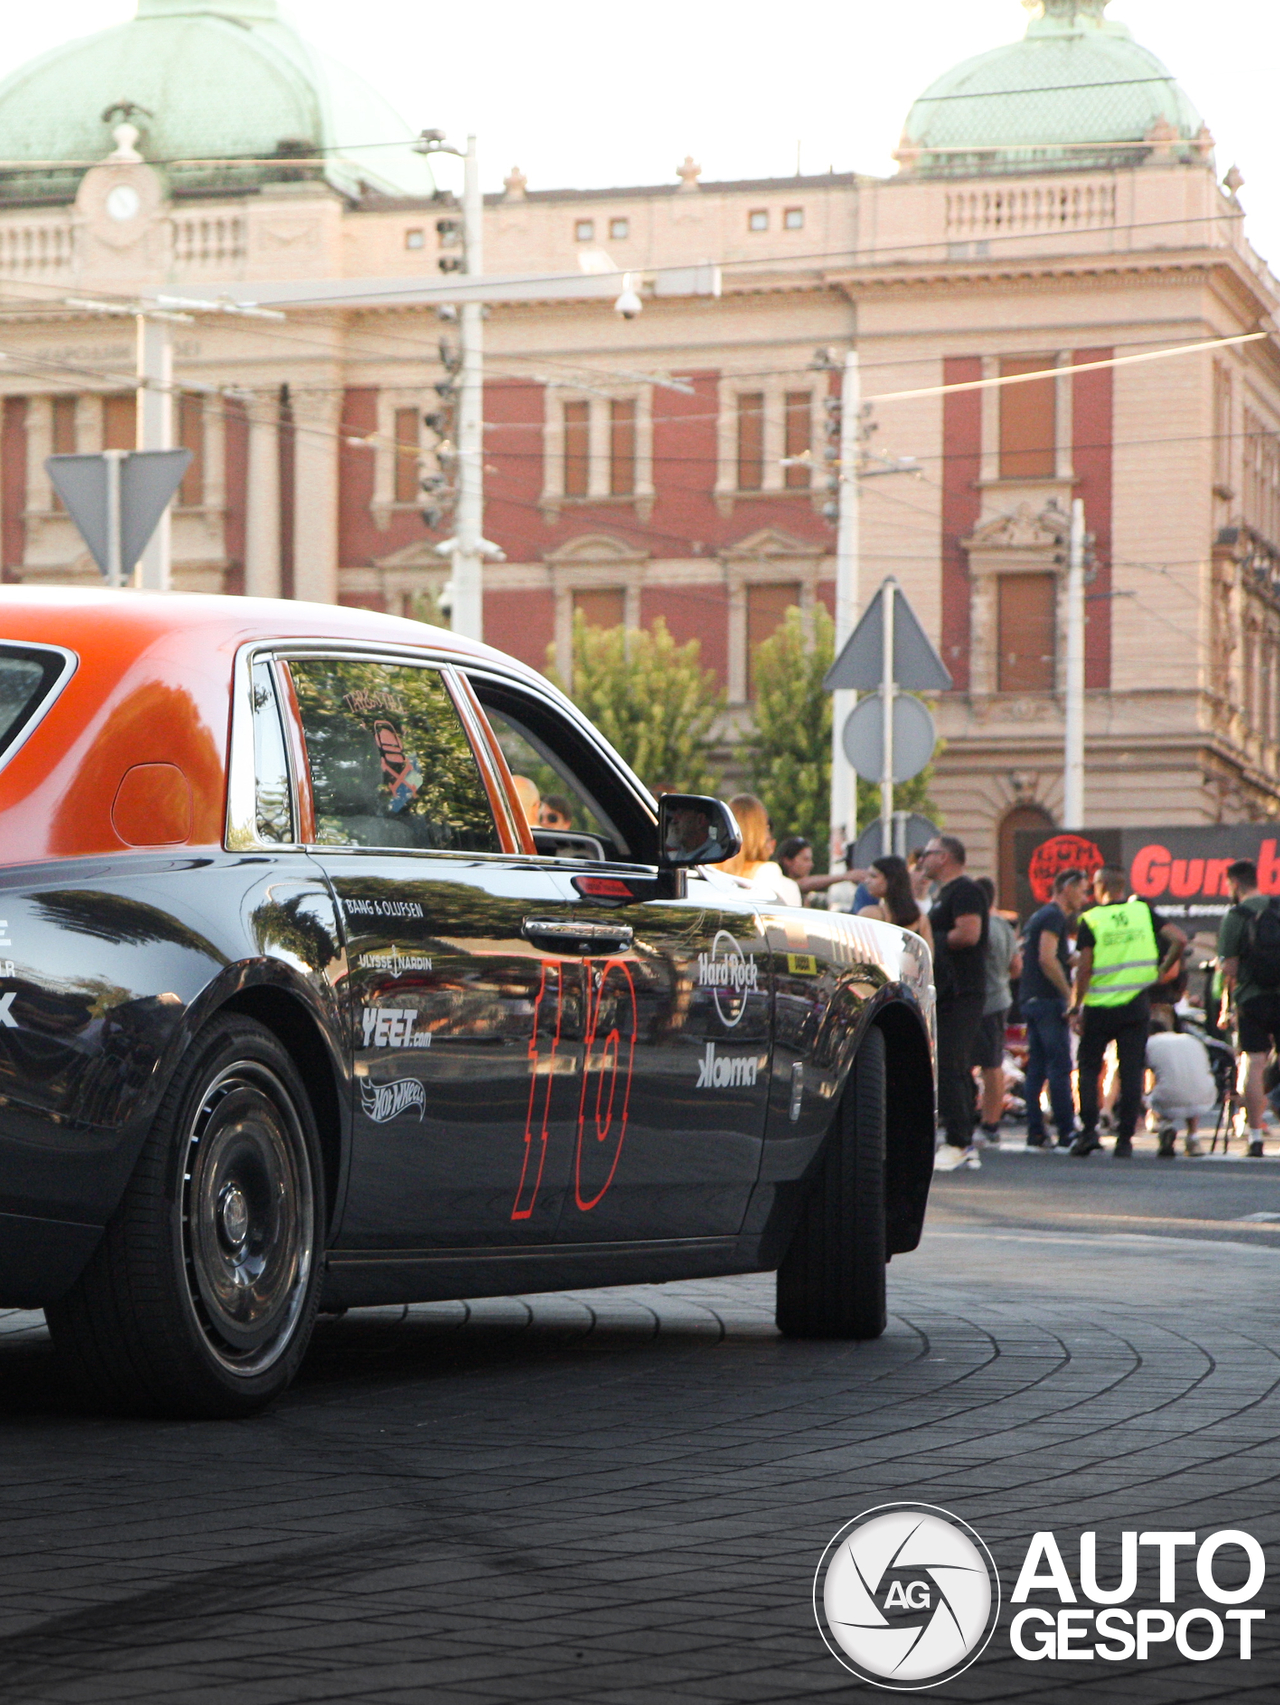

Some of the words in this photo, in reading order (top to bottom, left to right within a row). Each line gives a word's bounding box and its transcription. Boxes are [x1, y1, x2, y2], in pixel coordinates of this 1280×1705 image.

[345, 899, 374, 915] BANG
[375, 900, 383, 915] &
[382, 900, 424, 918] OLUFSEN
[359, 953, 393, 969] ULYSSE
[397, 955, 433, 971] NARDIN
[698, 952, 728, 986] Hard
[728, 952, 759, 994] Rock
[362, 1007, 432, 1048] YEET.com
